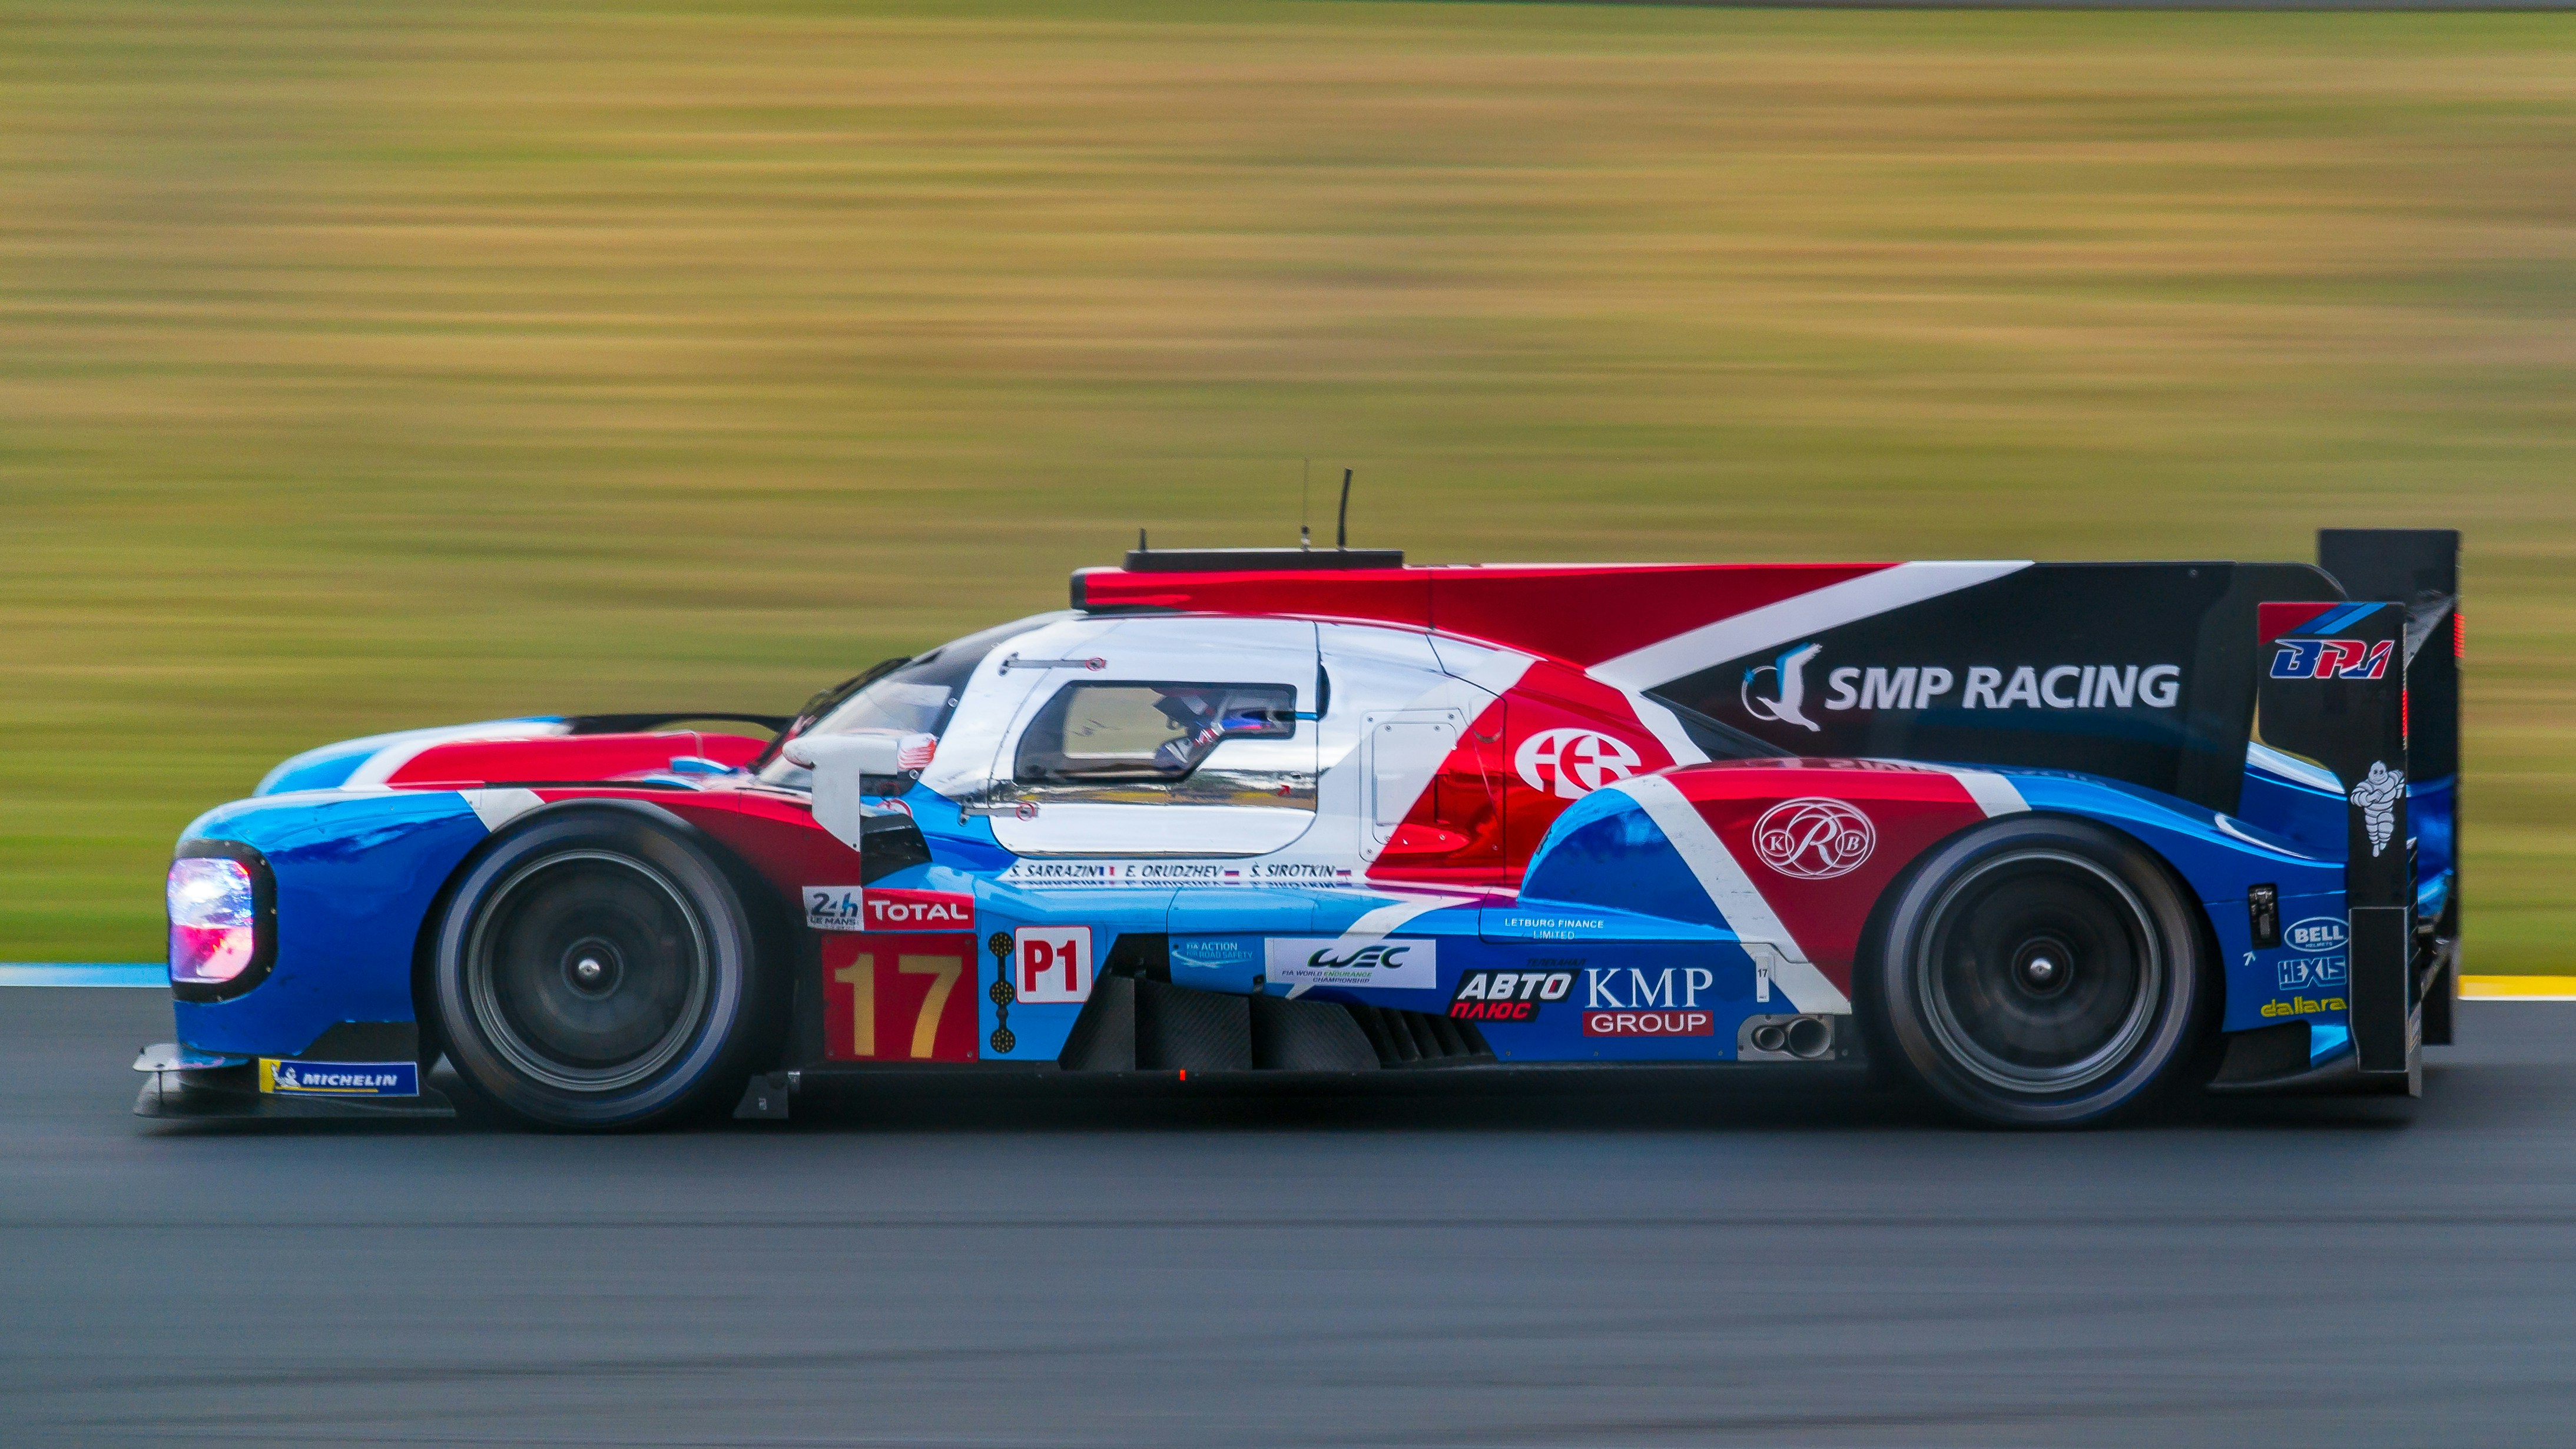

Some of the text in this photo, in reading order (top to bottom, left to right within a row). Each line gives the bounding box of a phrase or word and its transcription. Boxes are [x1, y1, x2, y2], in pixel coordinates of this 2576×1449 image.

[1825, 665, 2180, 709] SMP RACING
[1025, 864, 1099, 877] SARRAZIN
[1142, 864, 1224, 878] ORUDZHEV
[1266, 864, 1336, 878] SIROTKIN
[868, 900, 969, 922] TOTAL
[824, 917, 856, 926] MANS
[1505, 917, 1604, 929] LETBURG FINANCE
[1533, 930, 1575, 940] LIMITED
[2295, 926, 2344, 944] BELL
[1201, 942, 1238, 951] ACTION
[1023, 940, 1077, 992] P1
[1307, 946, 1411, 970] WEC
[1758, 969, 1768, 978] 17
[2278, 956, 2346, 990] HEXIS
[1457, 973, 1572, 1000] АВТО
[1584, 967, 1713, 1008] KMP
[834, 953, 963, 1059] 17
[1450, 1001, 1532, 1019] ПЛЮС
[2260, 996, 2348, 1017] dallara
[1591, 1014, 1706, 1033] GROUP
[302, 1073, 397, 1086] MICHELIN
